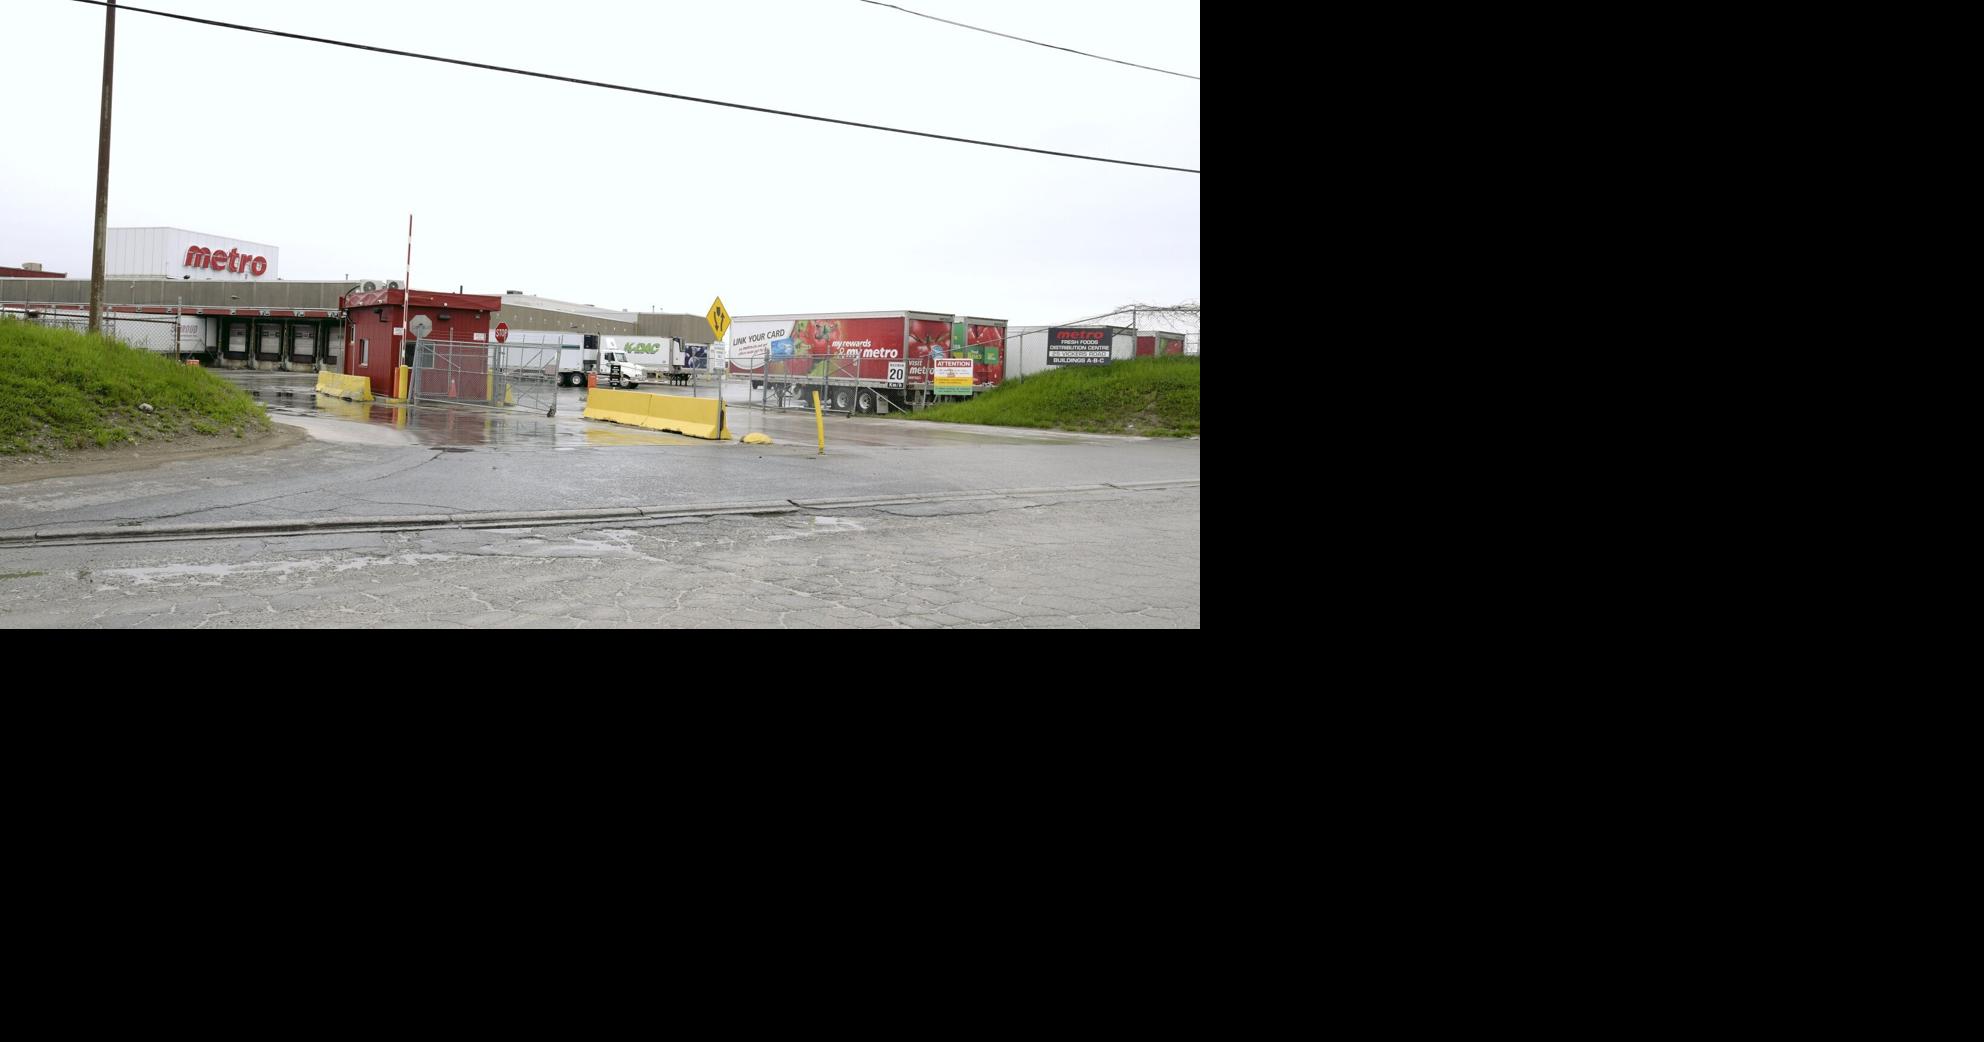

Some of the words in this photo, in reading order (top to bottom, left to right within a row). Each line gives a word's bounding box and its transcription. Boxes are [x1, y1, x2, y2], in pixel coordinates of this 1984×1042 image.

[184, 245, 267, 276] metro
[496, 329, 507, 337] STOP
[733, 336, 747, 346] LINK
[749, 333, 765, 342] YOUR
[767, 329, 785, 339] CARD
[1056, 331, 1104, 340] metro
[831, 340, 841, 349] my
[842, 339, 871, 348] rewards
[846, 348, 861, 362] my
[862, 347, 898, 358] metro
[889, 368, 904, 380] 20
